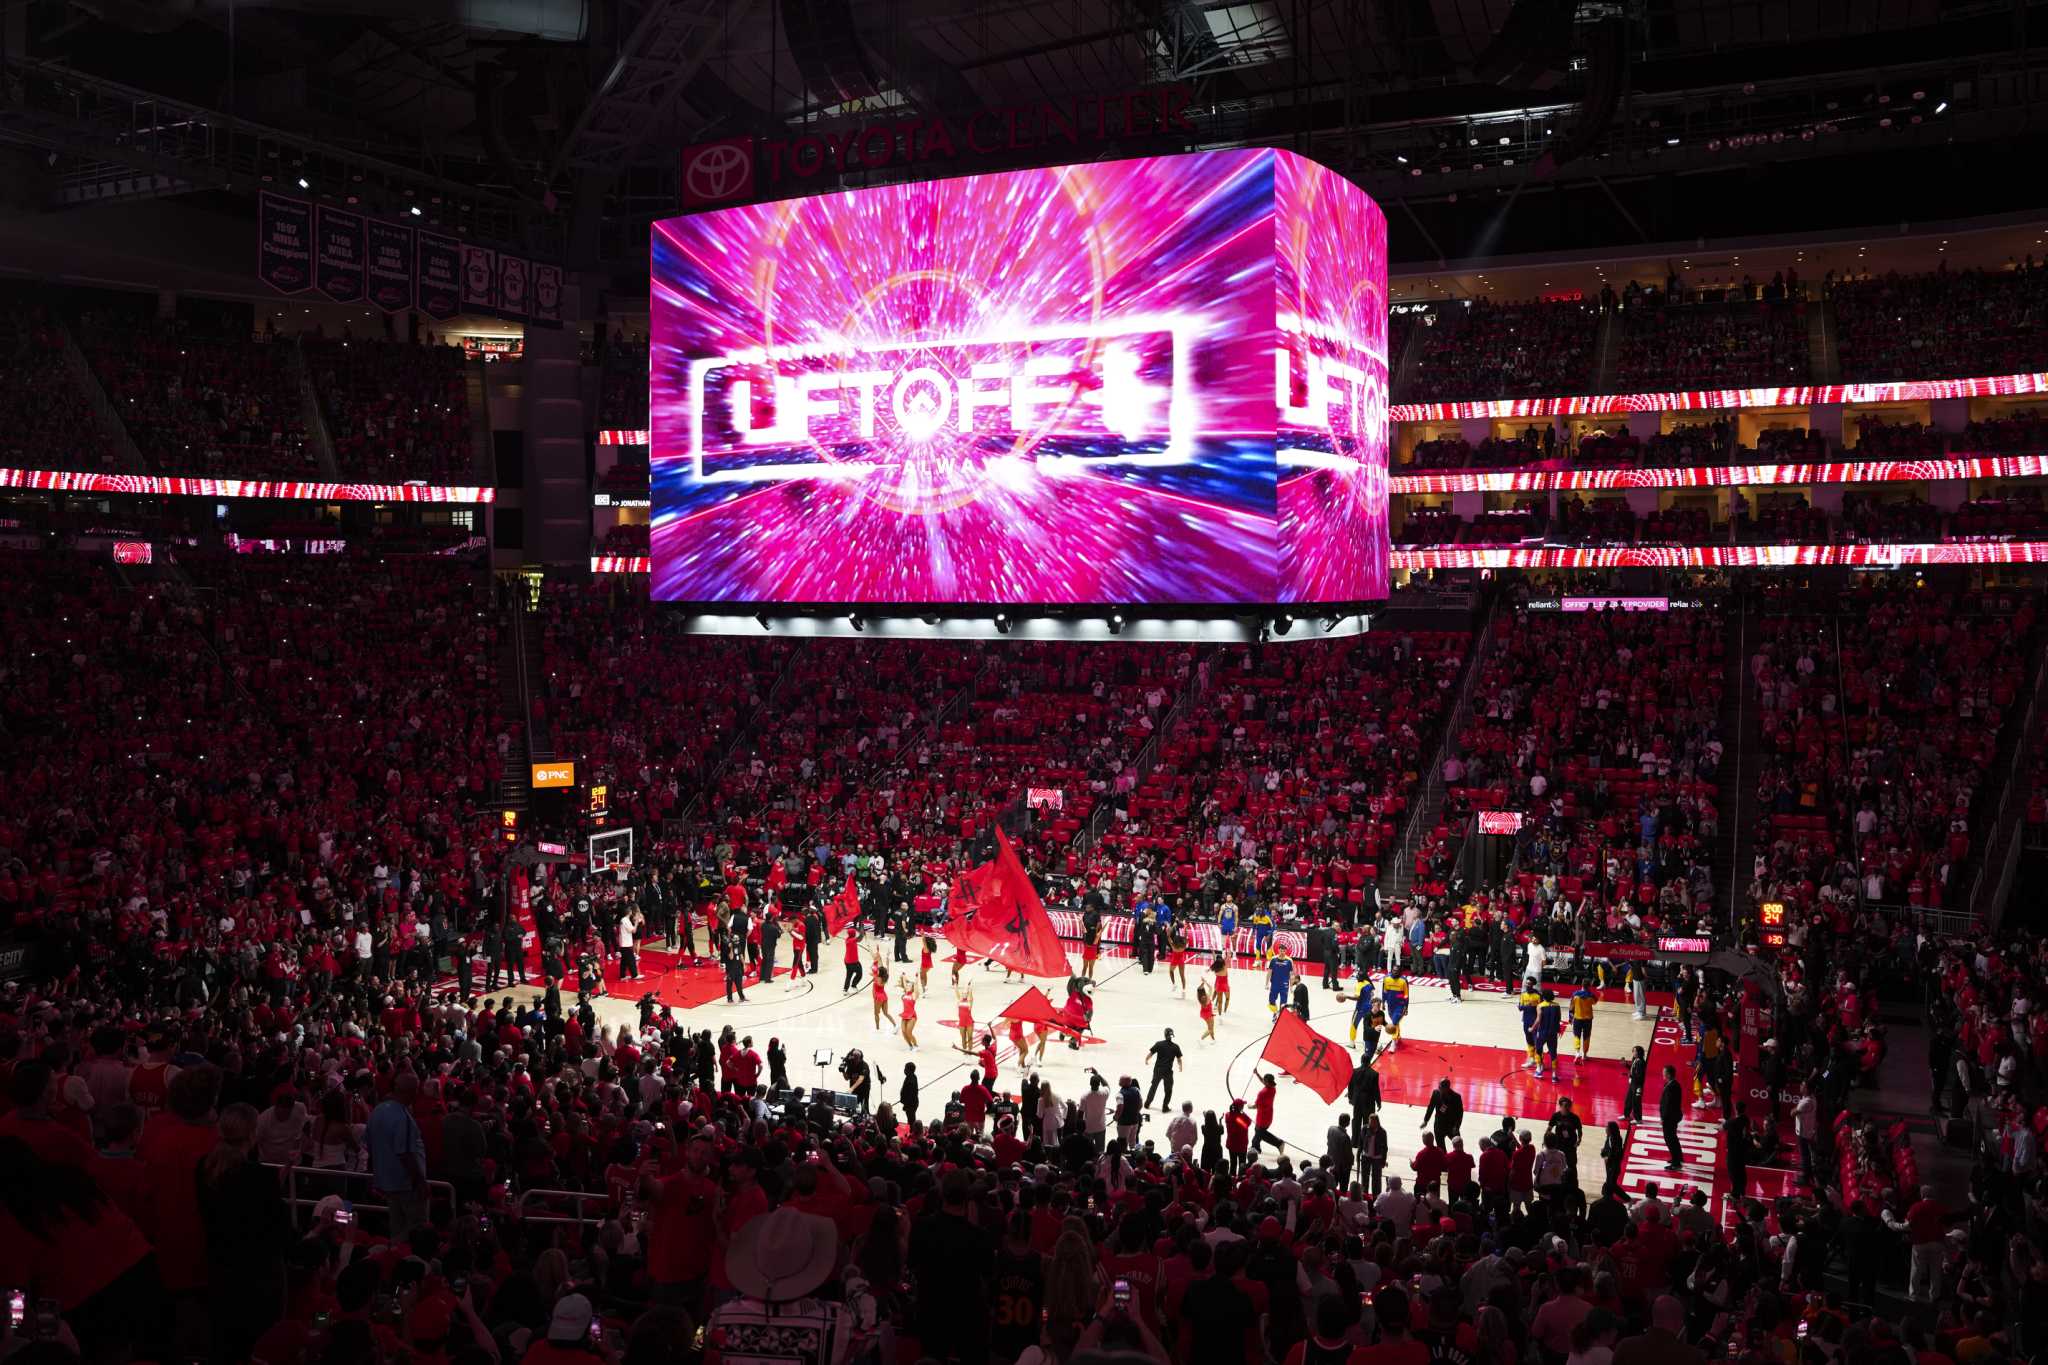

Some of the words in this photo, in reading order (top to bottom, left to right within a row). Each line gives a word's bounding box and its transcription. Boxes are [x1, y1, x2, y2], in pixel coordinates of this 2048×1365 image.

[764, 118, 956, 184] TOYOTA
[966, 87, 1197, 153] CENTER
[732, 356, 1074, 445] LIFTOFF
[548, 771, 569, 779] PNC
[591, 795, 605, 811] 24
[1763, 903, 1783, 914] 12:00
[1764, 912, 1779, 924] 24
[998, 1294, 1033, 1326] 30
